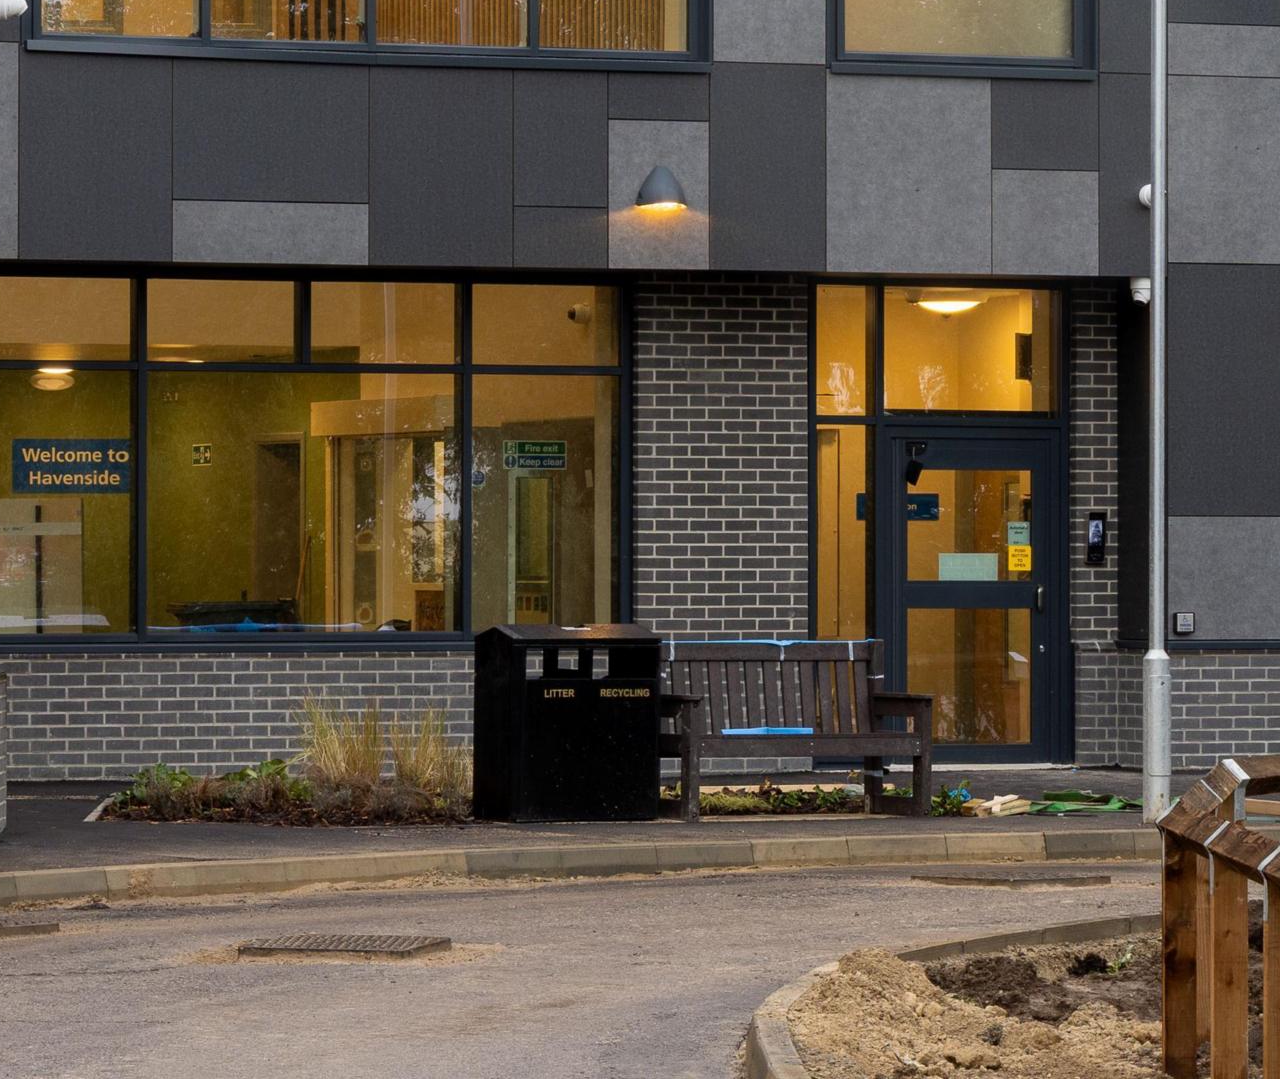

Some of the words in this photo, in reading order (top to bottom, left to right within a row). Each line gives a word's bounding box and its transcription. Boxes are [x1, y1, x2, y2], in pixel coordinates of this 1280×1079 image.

[524, 444, 541, 453] Fire
[542, 444, 558, 453] exit
[22, 447, 102, 463] Welcome
[108, 448, 130, 463] to
[519, 458, 541, 467] Keep
[542, 458, 563, 466] clear
[29, 470, 121, 486] Havenside
[544, 688, 575, 698] LITTER
[600, 688, 650, 698] RECYCLING
